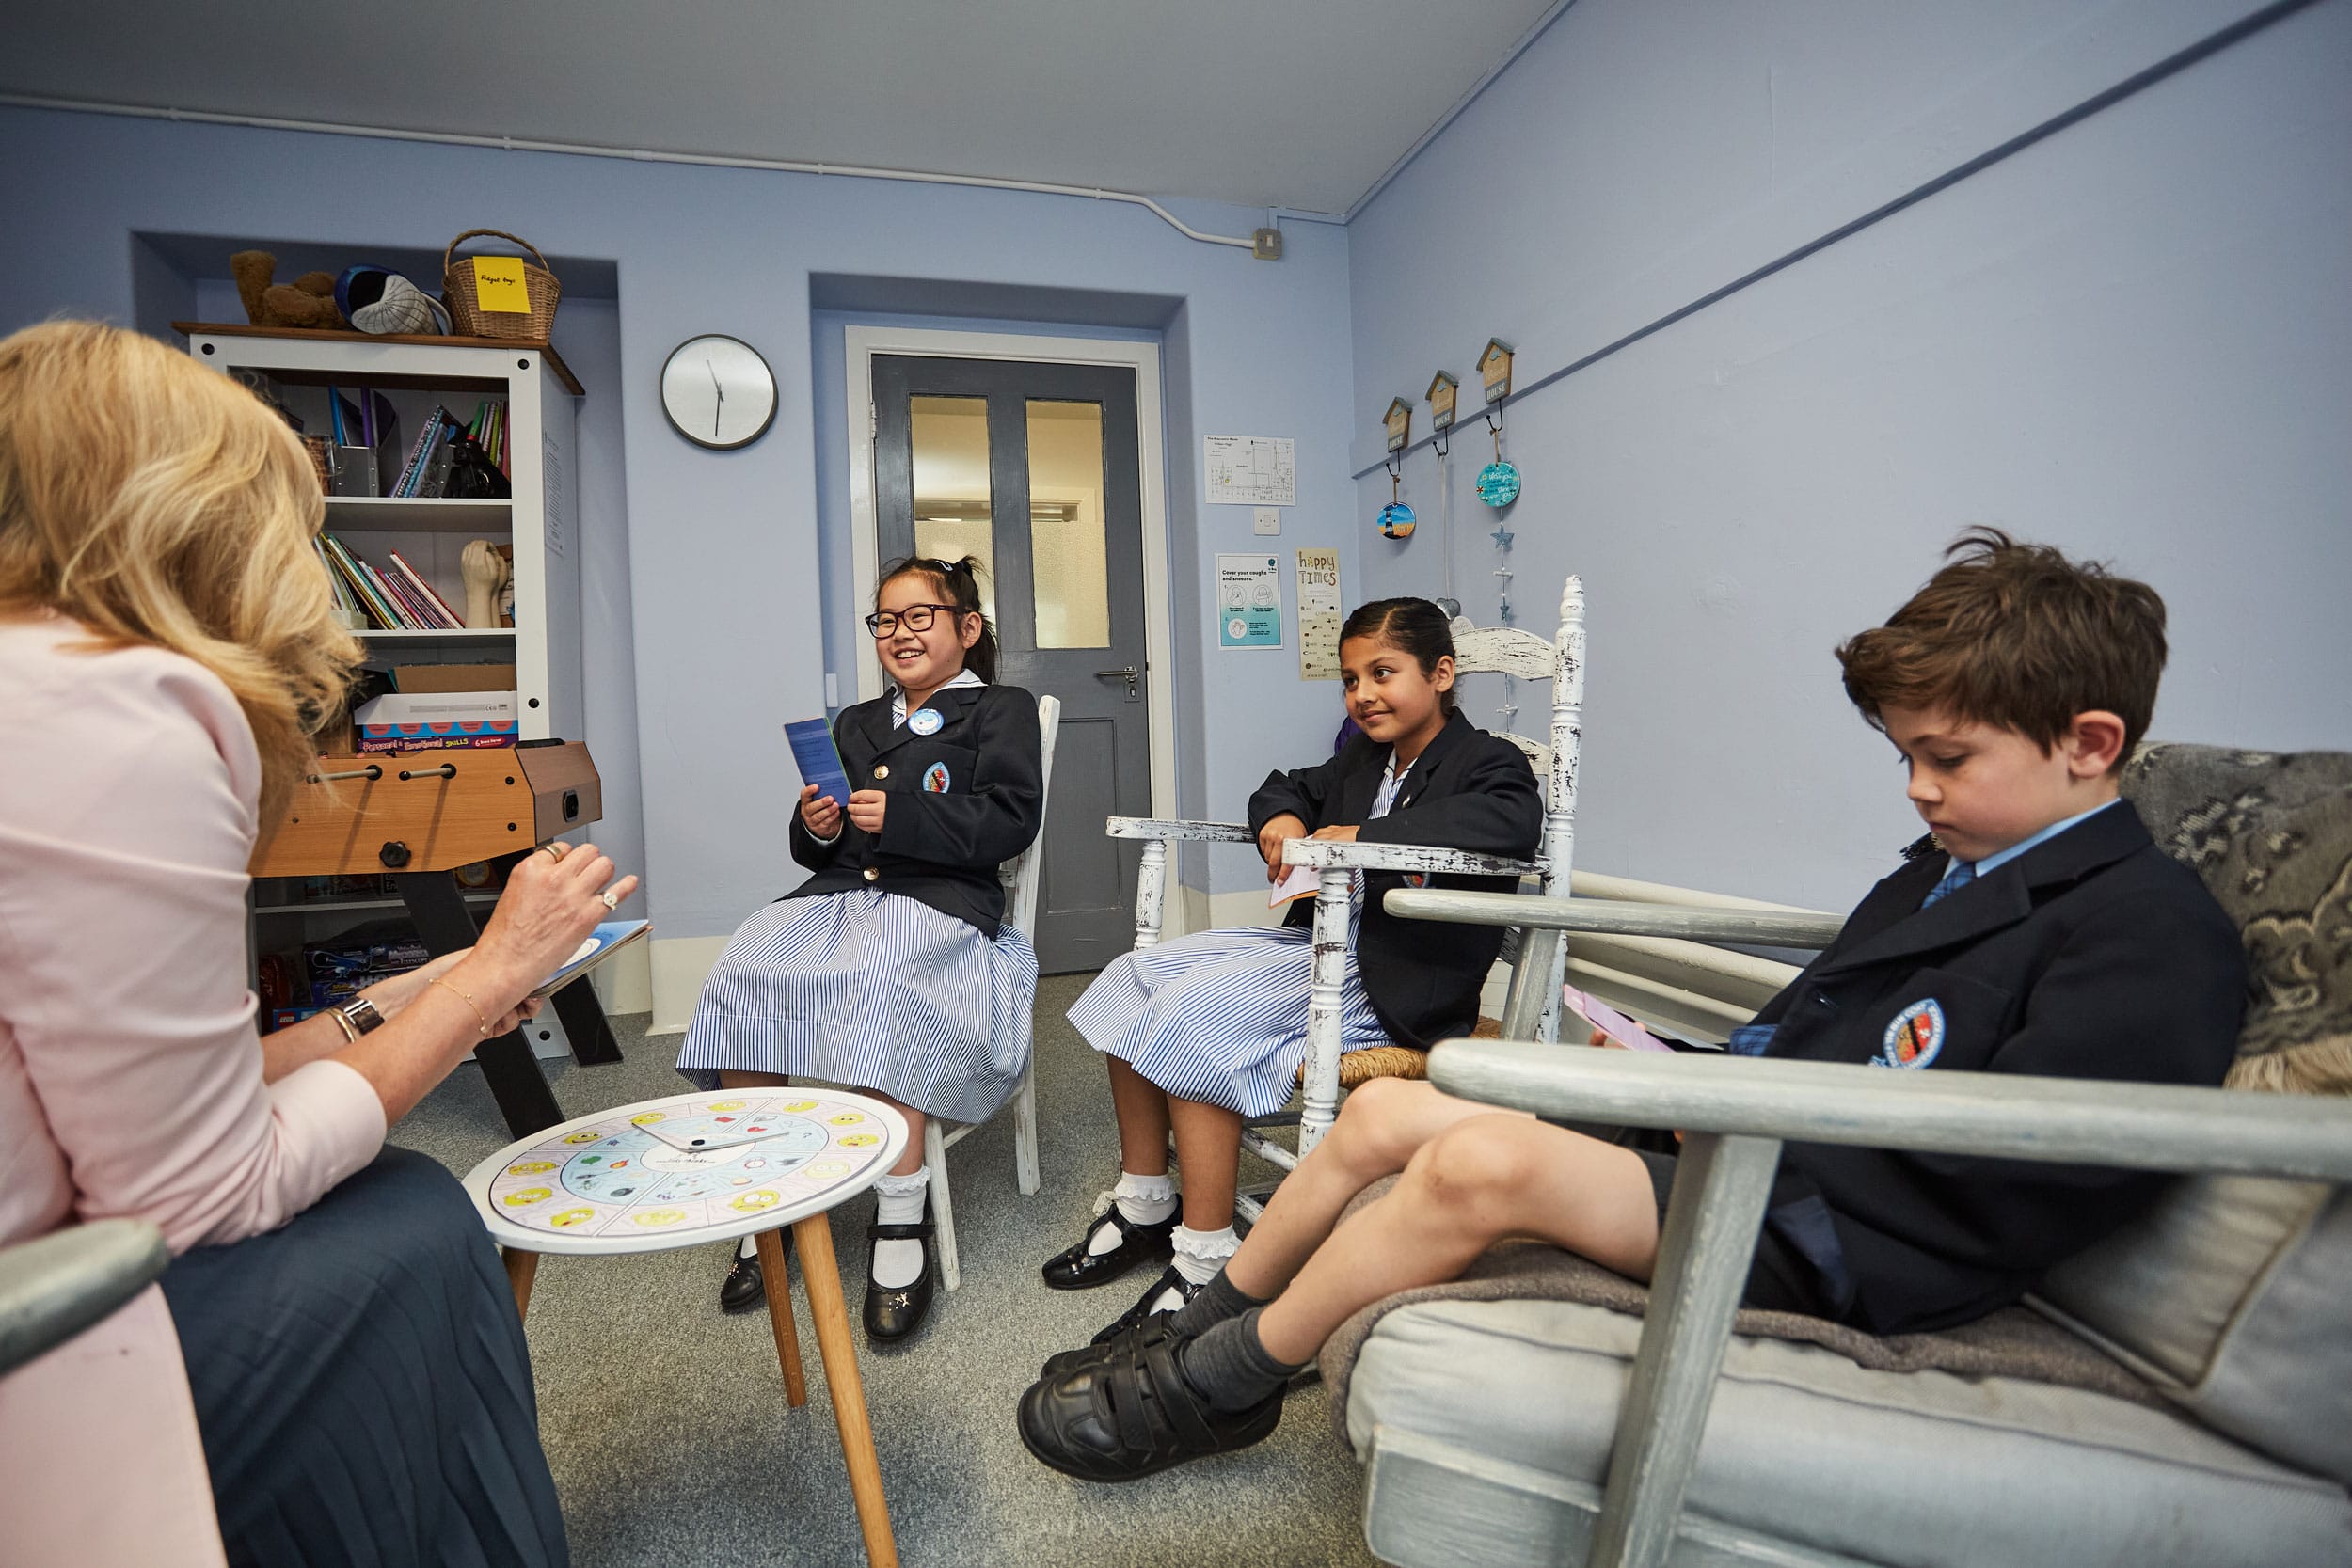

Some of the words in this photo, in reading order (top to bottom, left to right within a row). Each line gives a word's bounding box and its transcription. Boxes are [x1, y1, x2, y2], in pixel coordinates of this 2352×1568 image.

[1486, 382, 1506, 401] HOUSE
[1434, 411, 1452, 428] HOUSE
[1299, 551, 1335, 571] happy
[363, 739, 397, 752] Personal
[405, 738, 442, 751] Emotional
[445, 737, 469, 748] SKILLS
